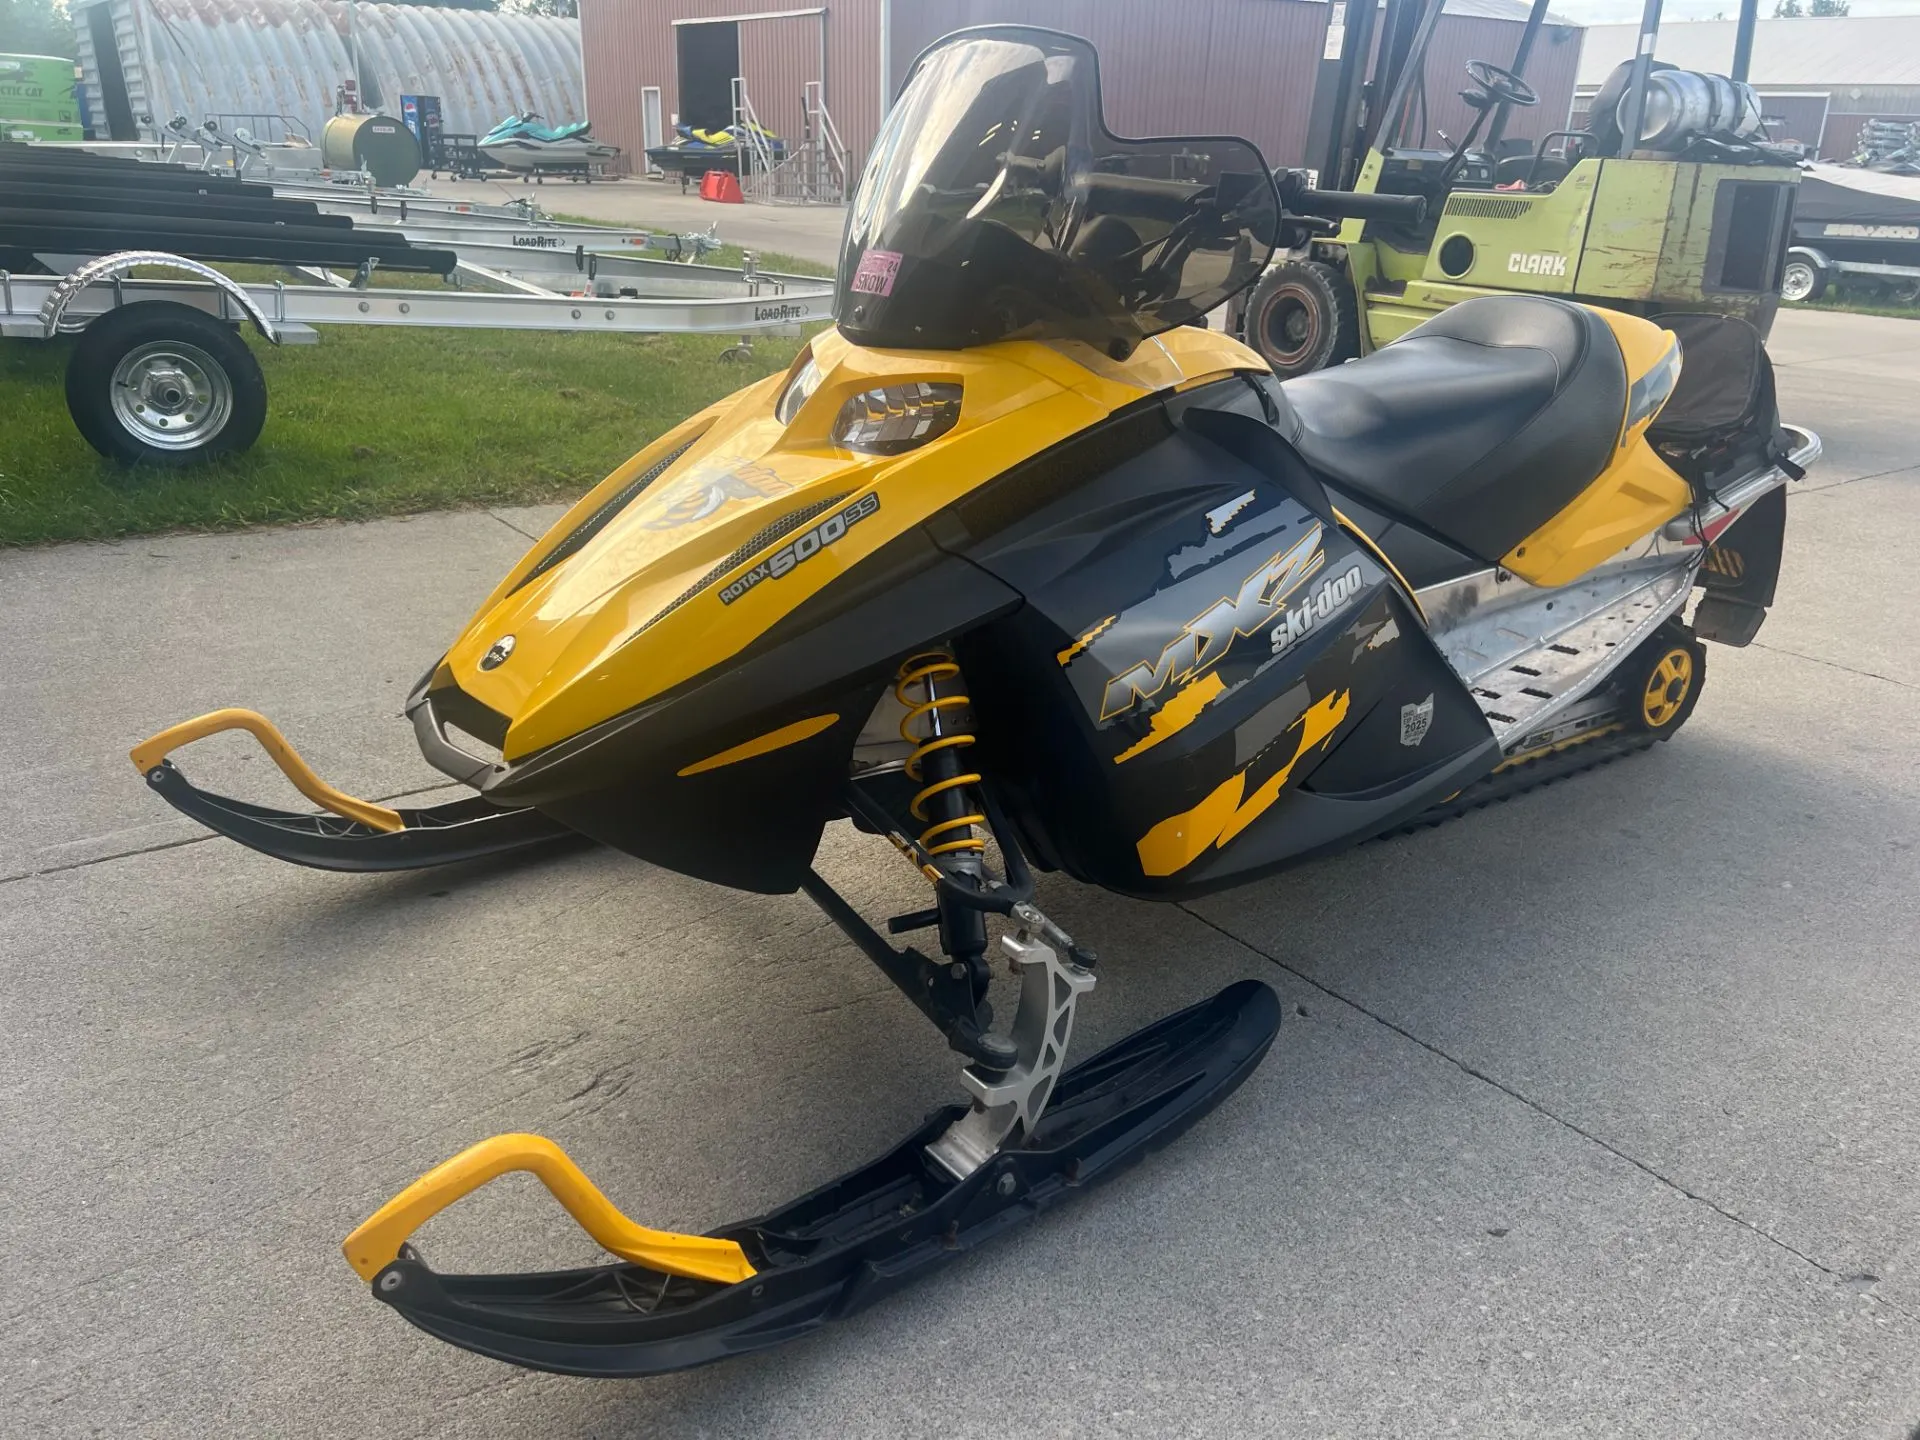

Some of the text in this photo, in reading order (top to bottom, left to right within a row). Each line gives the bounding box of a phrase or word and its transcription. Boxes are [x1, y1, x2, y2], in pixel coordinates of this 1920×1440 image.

[0, 86, 43, 97] CTIC CAT
[887, 260, 899, 273] 24
[1507, 253, 1567, 276] CLARK
[856, 273, 889, 294] SNOW
[720, 564, 769, 604] ROTAX
[1270, 564, 1364, 655] ski-doo
[1405, 718, 1427, 734] 2025
